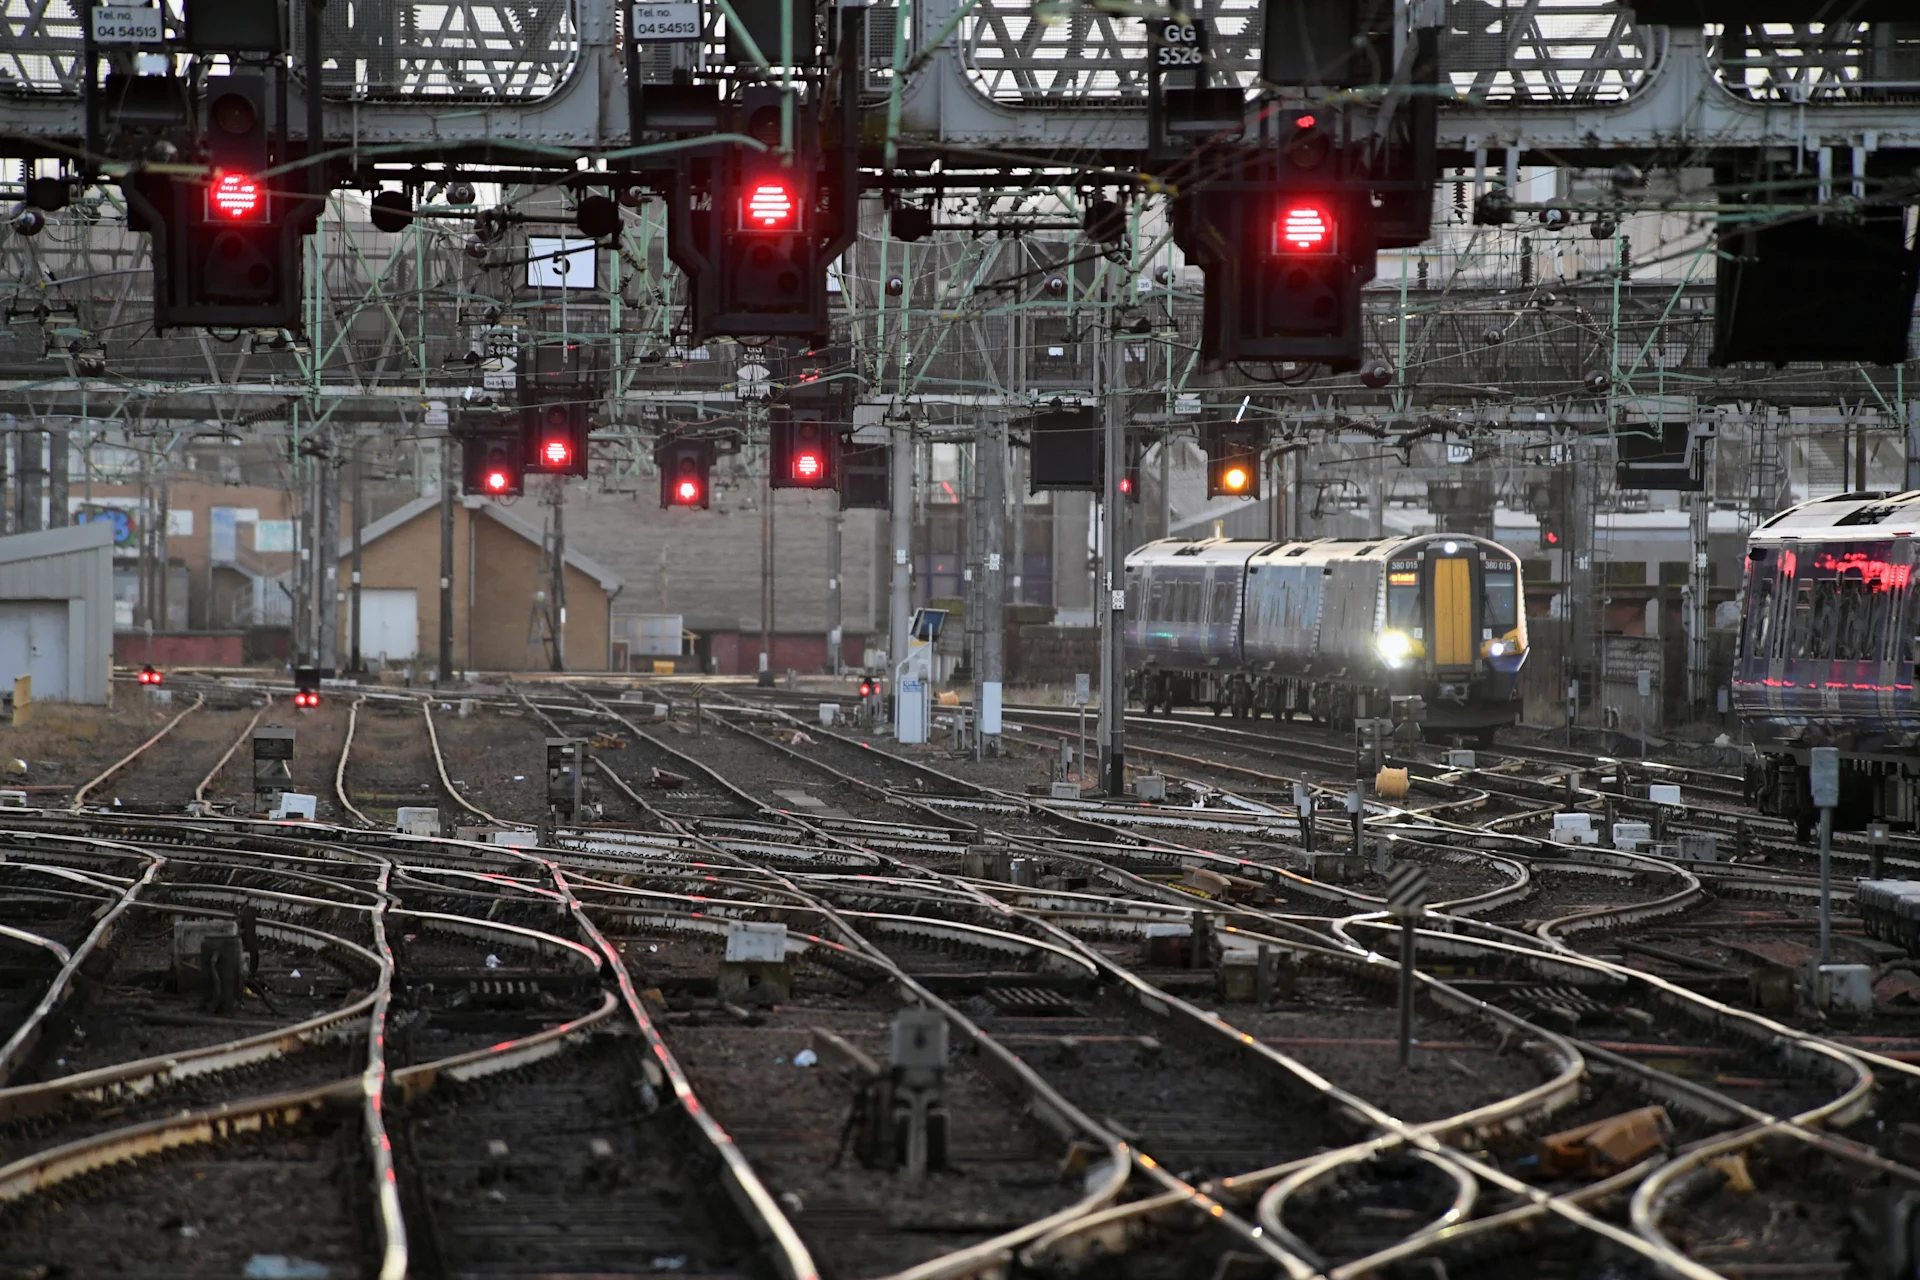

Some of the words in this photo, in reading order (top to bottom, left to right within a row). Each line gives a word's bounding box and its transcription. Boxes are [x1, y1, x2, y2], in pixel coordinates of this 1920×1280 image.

[117, 12, 132, 20] no.
[638, 9, 654, 17] Tel.
[656, 9, 672, 17] no.
[97, 26, 115, 37] 04
[118, 26, 157, 37] 54513
[638, 23, 655, 34] 04
[658, 22, 696, 34] 54513
[1164, 24, 1196, 42] GG
[1158, 46, 1203, 65] 5526
[552, 251, 571, 275] 5
[1391, 561, 1405, 570] 380
[1405, 560, 1418, 569] 015
[1485, 561, 1498, 570] 380
[1498, 561, 1511, 571] 015
